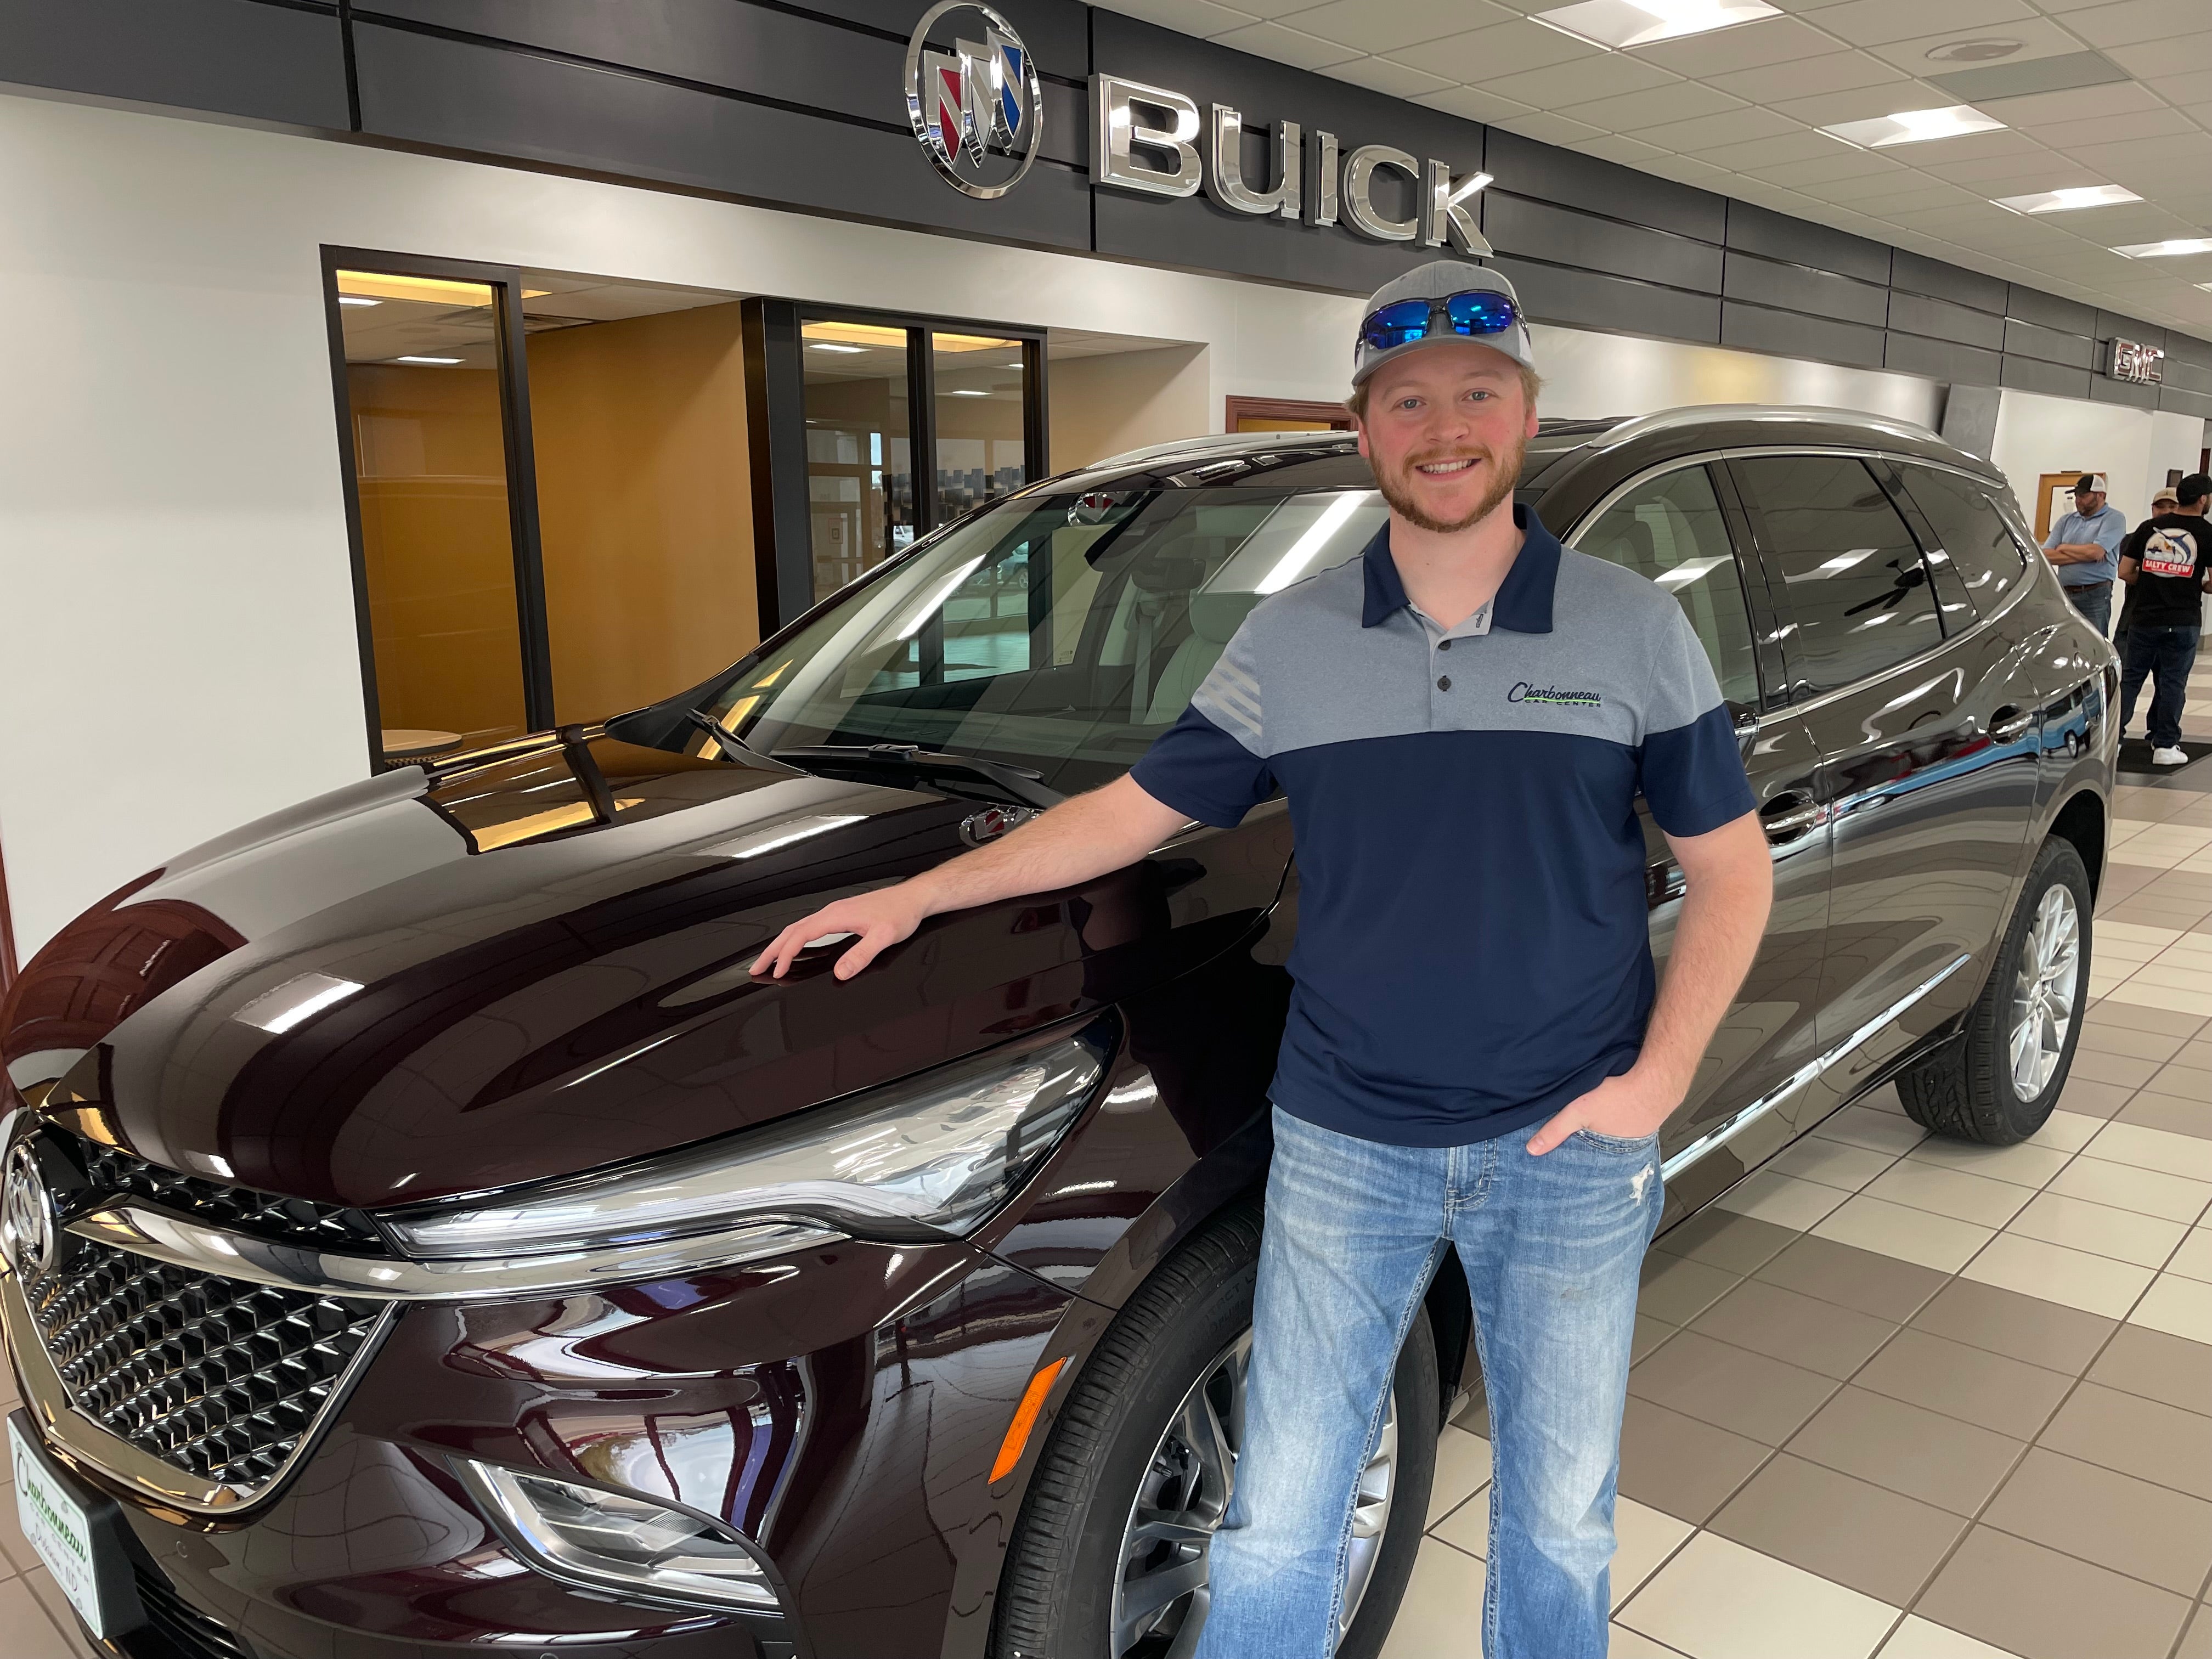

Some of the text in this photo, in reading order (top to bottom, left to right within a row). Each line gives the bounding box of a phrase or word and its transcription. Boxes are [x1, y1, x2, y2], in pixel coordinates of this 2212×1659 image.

[1091, 72, 1494, 258] BUICK
[2110, 337, 2164, 385] GMC
[2145, 560, 2166, 569] SALTY
[2168, 564, 2191, 573] CREW
[1507, 681, 1601, 703] Charbonneau
[17, 1452, 86, 1562] Charbonneau
[65, 1565, 78, 1592] ND
